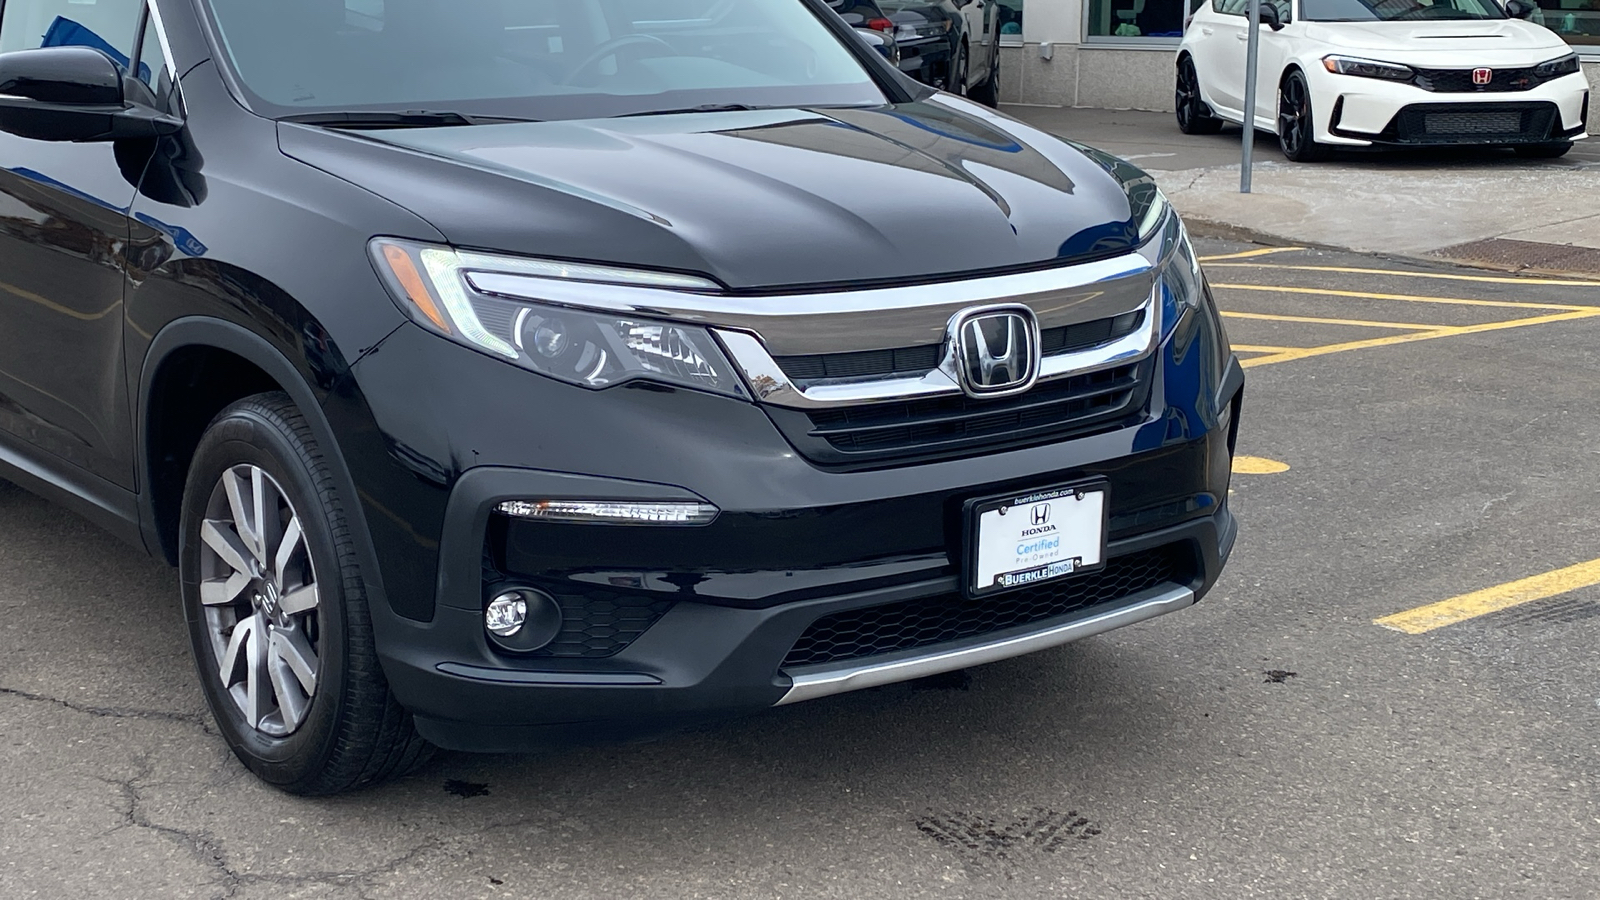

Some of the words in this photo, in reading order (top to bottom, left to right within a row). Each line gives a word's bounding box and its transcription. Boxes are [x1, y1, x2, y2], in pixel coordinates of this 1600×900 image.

[1014, 488, 1074, 505] buerklehonda.com
[1021, 524, 1057, 537] HONDA
[1016, 536, 1060, 555] Certified
[1015, 549, 1060, 565] Pre-Owned
